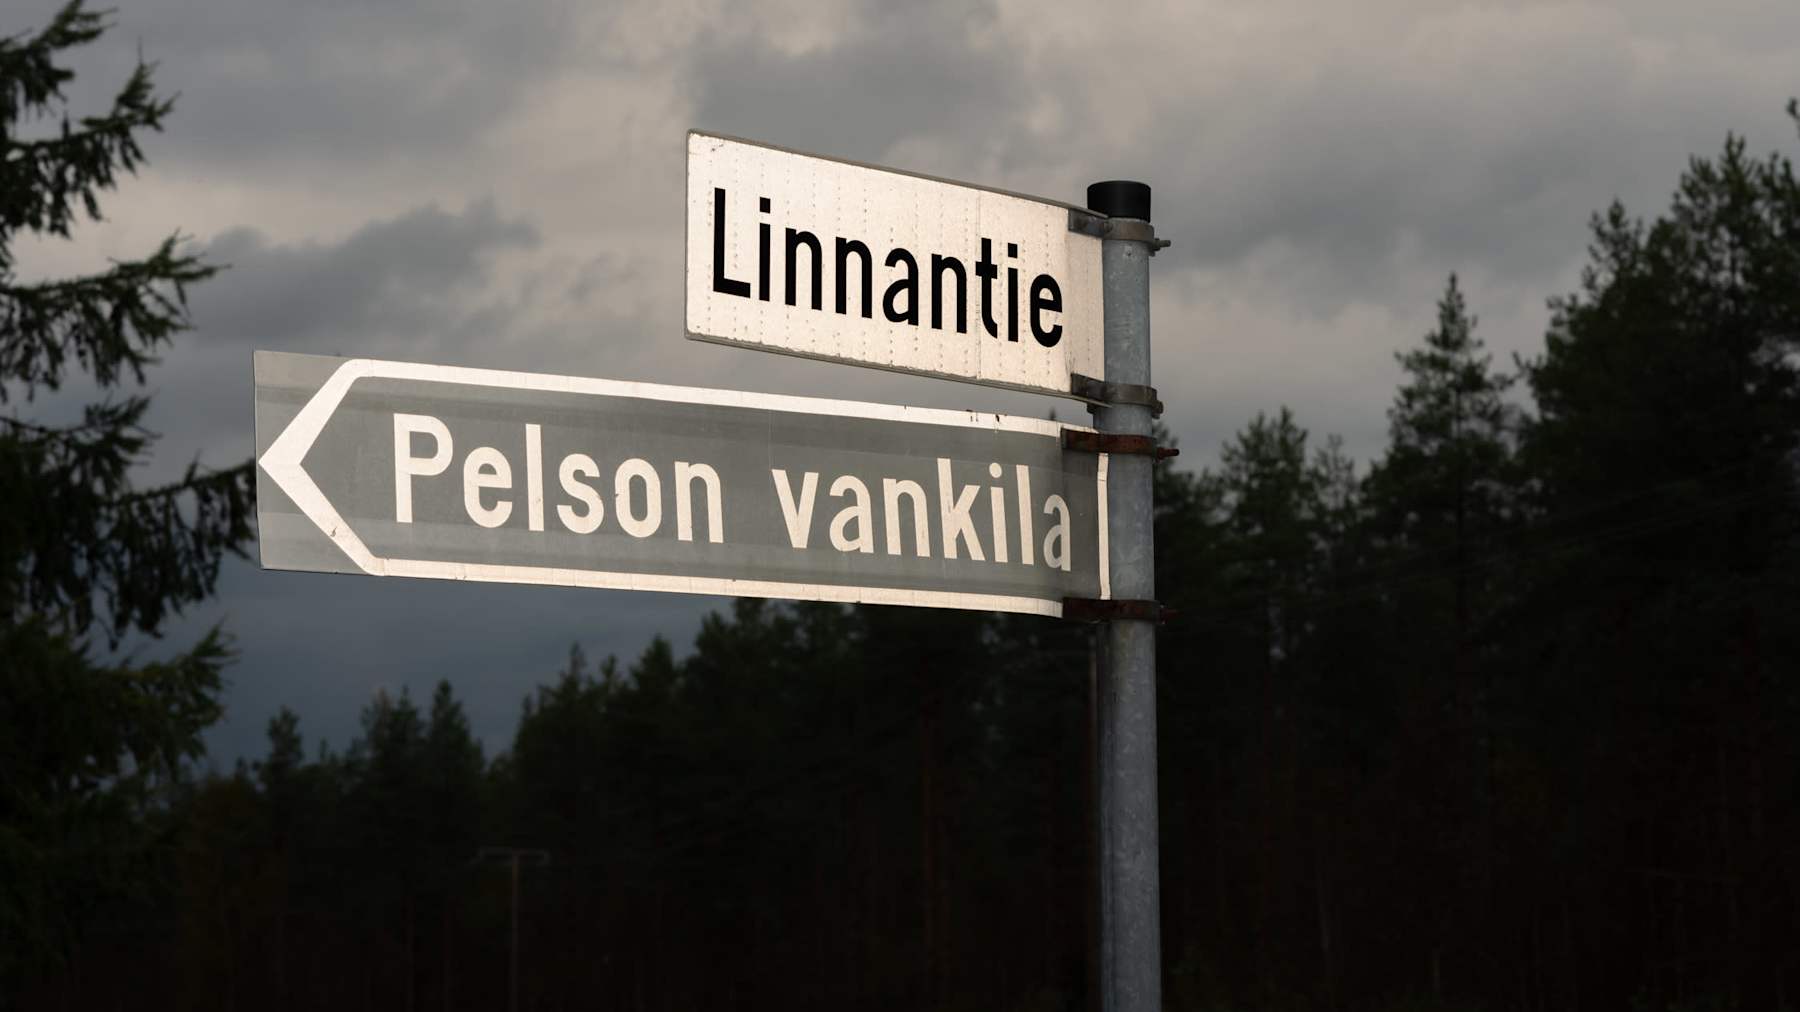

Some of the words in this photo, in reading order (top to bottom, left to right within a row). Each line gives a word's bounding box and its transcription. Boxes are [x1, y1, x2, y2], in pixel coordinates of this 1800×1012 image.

[712, 187, 1063, 348] Linnantie
[392, 412, 724, 544] Pelson
[771, 457, 1071, 572] vankila
